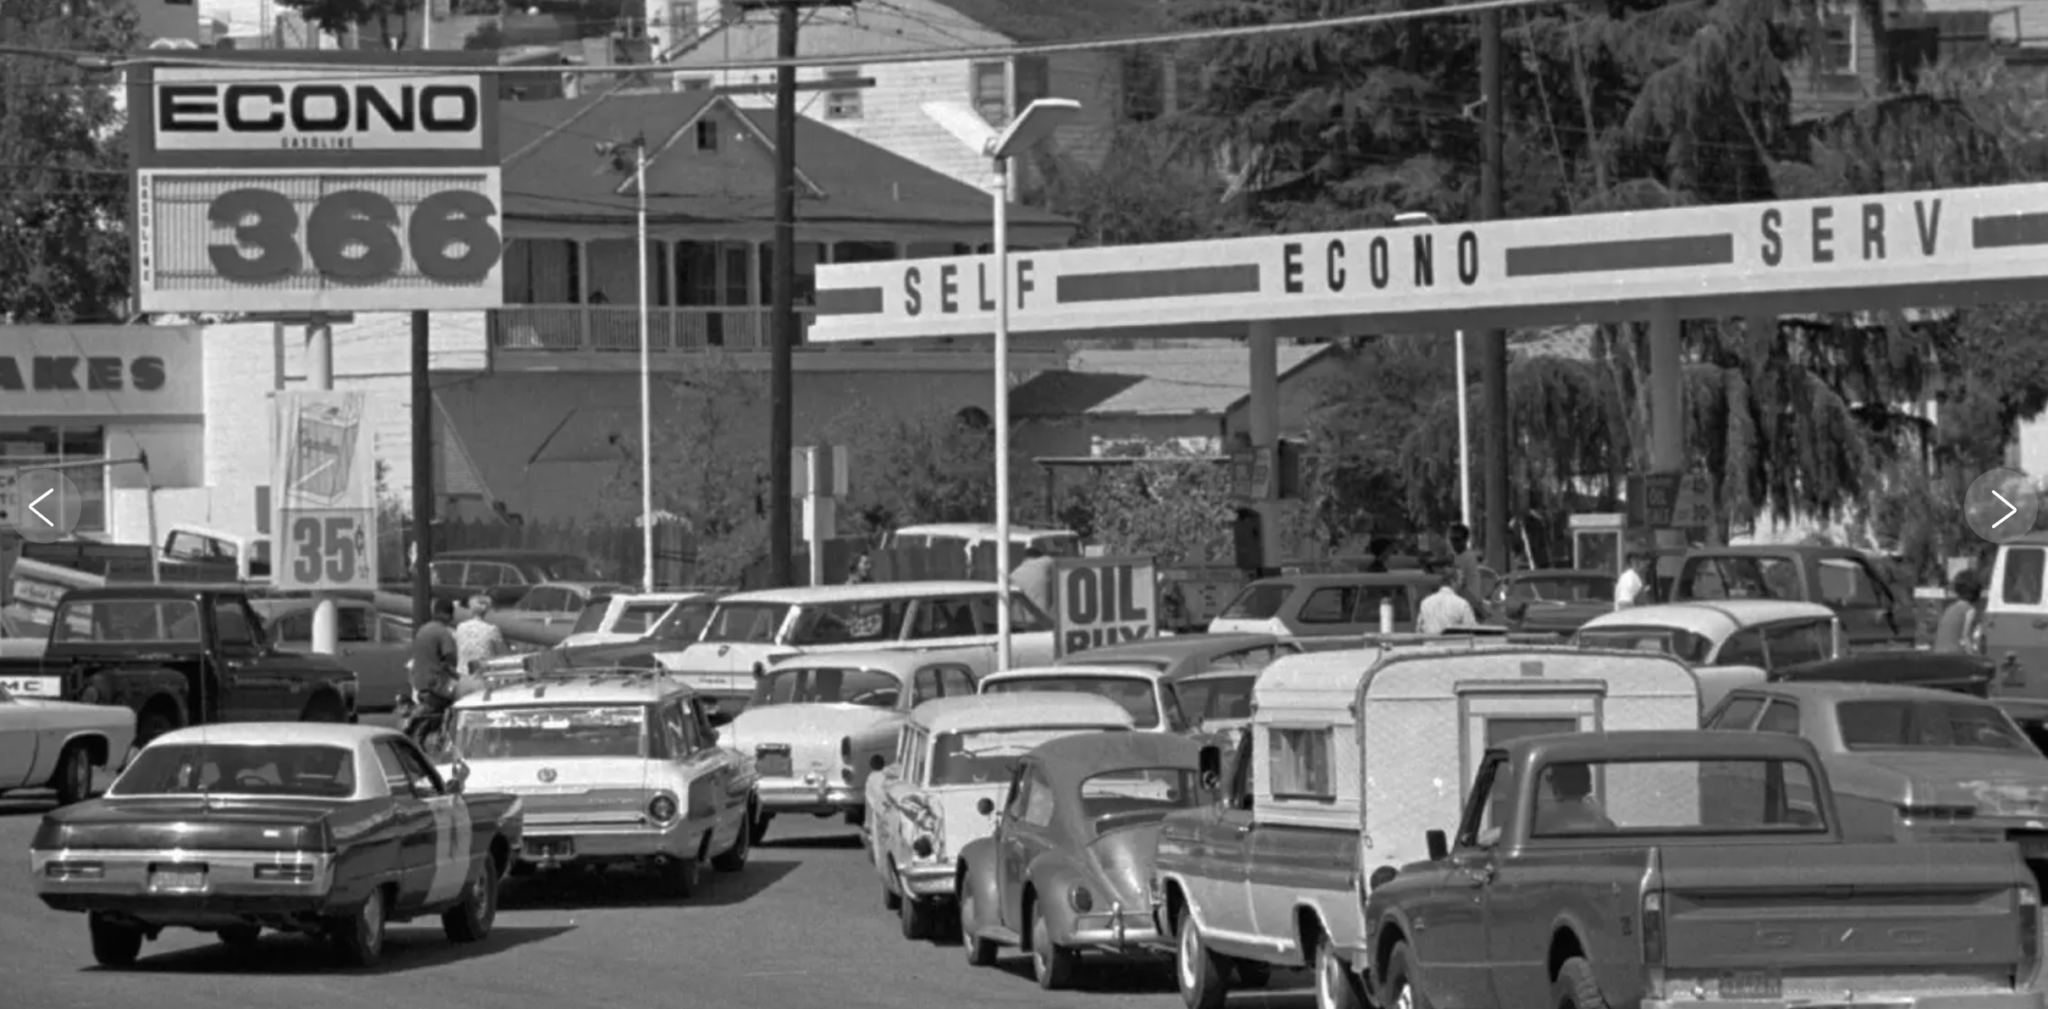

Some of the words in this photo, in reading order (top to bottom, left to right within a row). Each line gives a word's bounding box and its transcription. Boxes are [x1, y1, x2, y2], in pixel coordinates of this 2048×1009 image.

[159, 85, 477, 132] ECONO
[281, 136, 354, 149] GASOLINE
[141, 175, 150, 282] GASOLINE
[207, 187, 502, 286] 366
[904, 259, 1034, 316] SELF
[1283, 230, 1479, 293] ECONO
[1761, 198, 1941, 267] SERV
[1067, 565, 1147, 625] OIL
